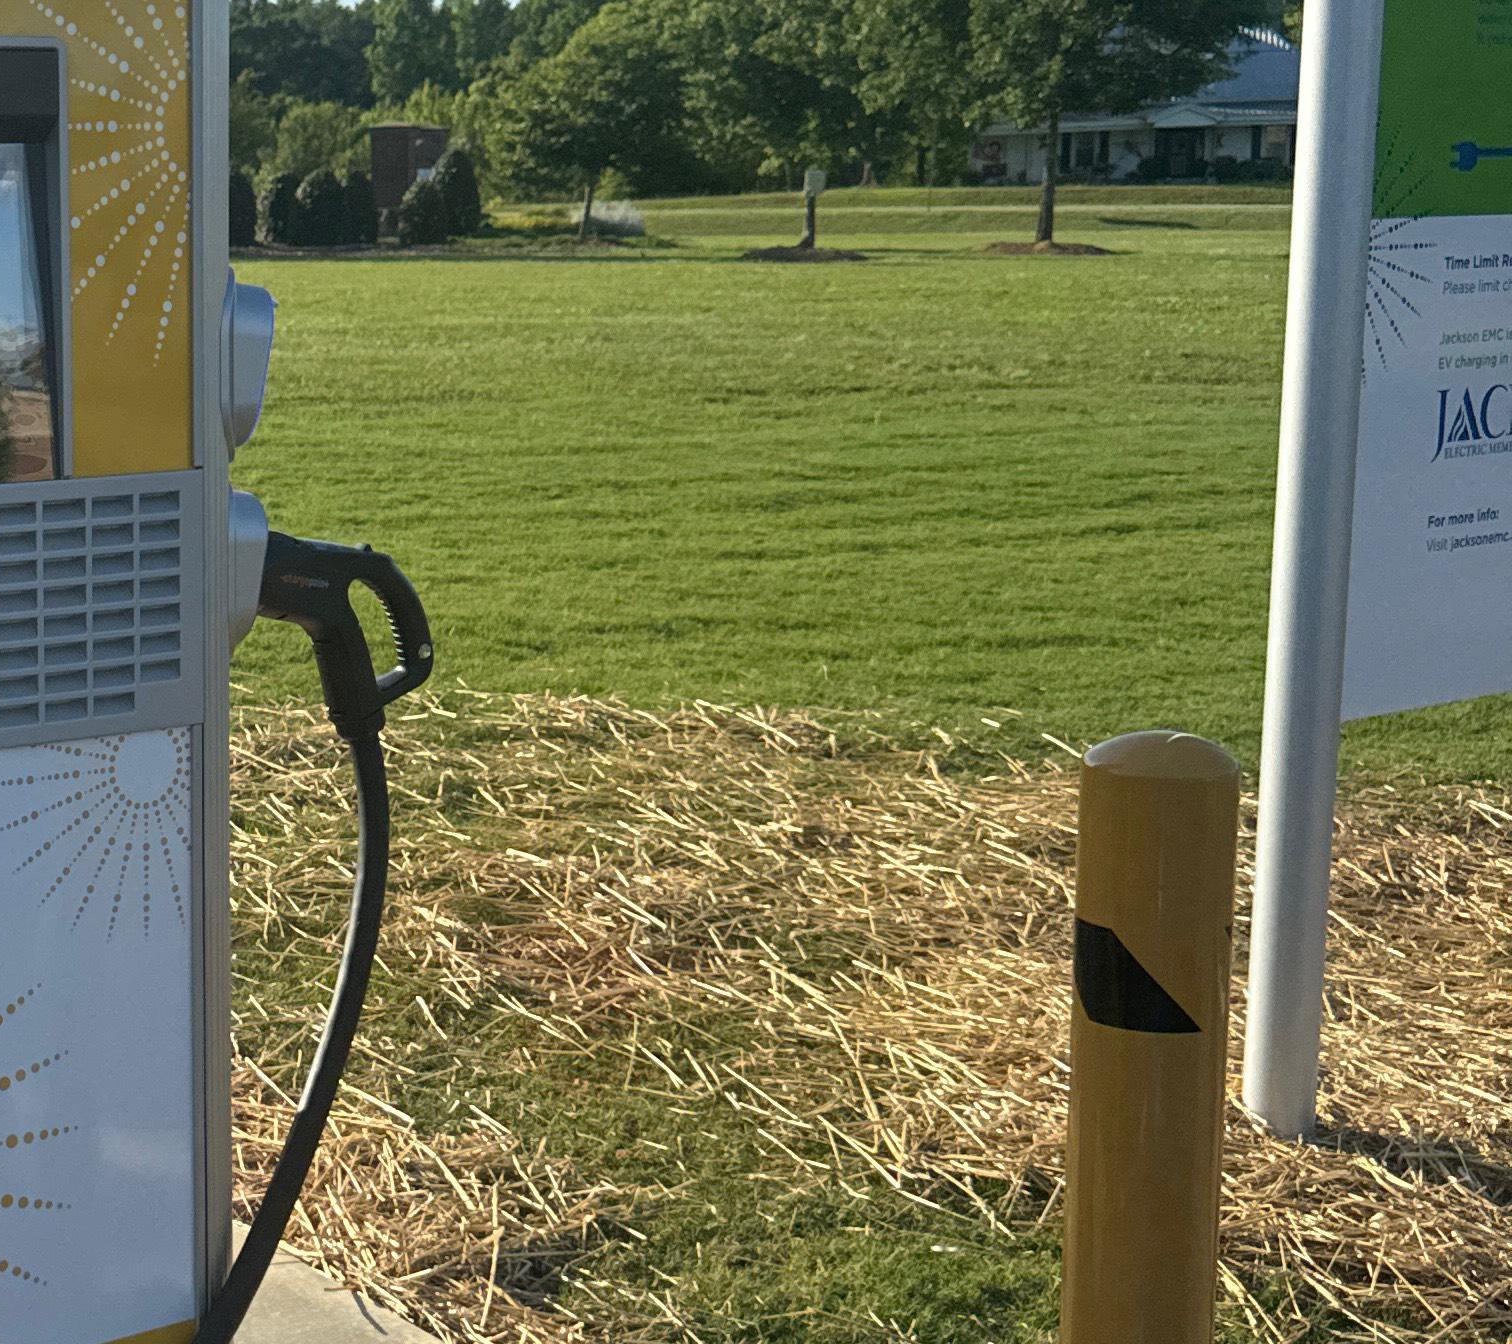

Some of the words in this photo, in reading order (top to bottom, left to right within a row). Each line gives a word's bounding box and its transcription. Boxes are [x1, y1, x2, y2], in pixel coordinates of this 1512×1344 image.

[1444, 256, 1471, 270] Time
[1473, 254, 1500, 269] Limit
[1443, 281, 1476, 294] Please
[1478, 278, 1501, 293] limit
[1440, 331, 1479, 345] Jackson
[1481, 328, 1505, 343] EMC
[1439, 357, 1452, 369] EV
[1455, 354, 1497, 369] charging
[1430, 383, 1512, 463] JAC
[1444, 444, 1487, 460] ELECTRIC
[1427, 514, 1446, 529] For
[1447, 512, 1475, 526] more
[1477, 507, 1500, 523] info:
[1426, 537, 1448, 553] Visit
